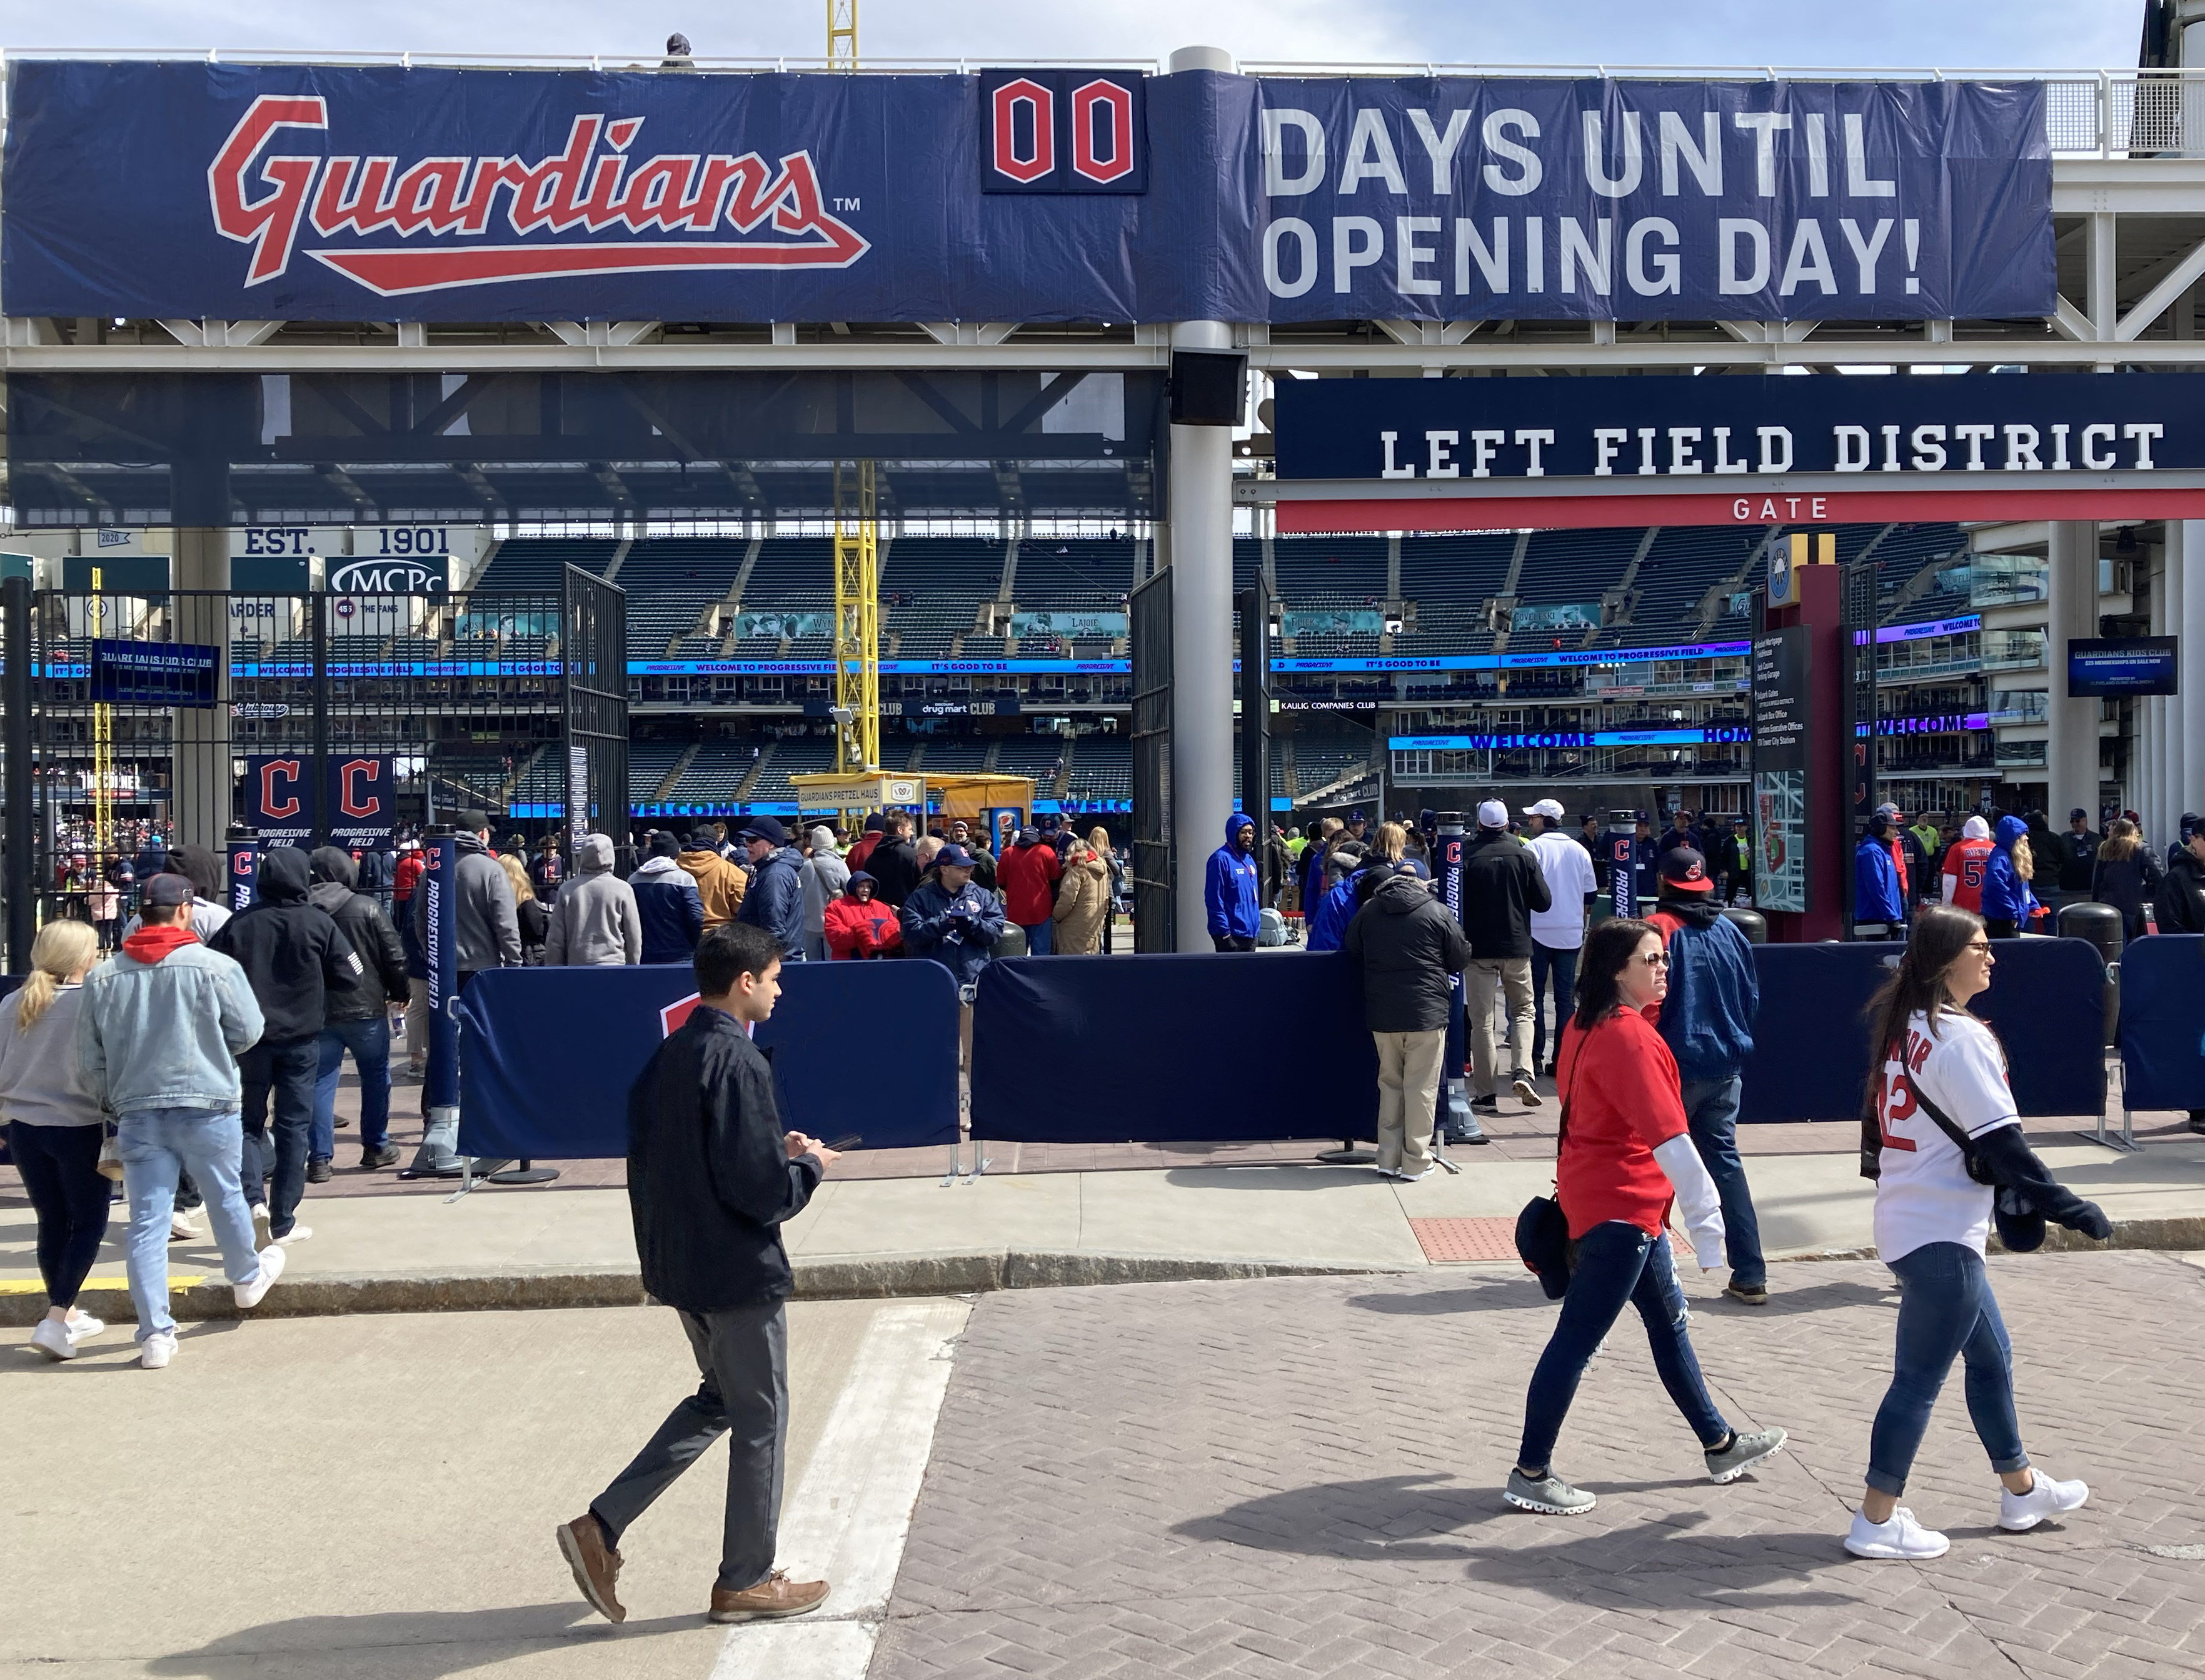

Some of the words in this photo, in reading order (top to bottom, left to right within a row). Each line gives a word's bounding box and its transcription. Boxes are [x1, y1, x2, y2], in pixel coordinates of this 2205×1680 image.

[992, 77, 1135, 184] 00
[1262, 108, 1543, 196] DAYS
[1582, 109, 1896, 198] UNTIL
[208, 94, 863, 292] Guardians
[833, 198, 861, 211] TM
[1263, 216, 1680, 299] OPENING
[1719, 218, 1921, 296] DAY!
[1380, 429, 1555, 479] LEFT
[1594, 426, 1793, 476] FIELD
[1833, 423, 2164, 472] DISTRICT
[1732, 497, 1827, 521] GATE
[101, 533, 119, 542] 2020
[245, 528, 315, 554] EST.
[379, 528, 449, 554] 1901
[361, 605, 376, 613] THE
[378, 605, 398, 613] FANS
[1514, 611, 1555, 622] COVELESKI
[1072, 618, 1098, 627] LAJOIE
[1942, 619, 1973, 631] WELCOME
[1559, 654, 1602, 662] WELCOME
[1604, 653, 1616, 661] TO
[1618, 649, 1680, 659] PROGRESSIVE
[1681, 648, 1704, 656] FIELD
[2074, 649, 2124, 659] GUARDIANS
[2126, 649, 2147, 658] KIDS
[2148, 648, 2171, 657] CLUB
[922, 704, 944, 715] drug
[945, 704, 967, 713] mart
[970, 702, 995, 715] CLUB
[1776, 709, 1787, 719] Office
[1788, 721, 1803, 731] Offices
[1876, 714, 1969, 735] WELCOME
[1469, 732, 1596, 749] WELCOME
[1779, 735, 1796, 745] Station
[260, 758, 300, 819] C
[341, 758, 380, 819] C
[800, 790, 833, 802] GUARDIANS
[833, 789, 860, 801] PRETZEL
[861, 788, 878, 800] HAUS
[1333, 792, 1347, 801] drug
[1347, 789, 1361, 799] mart
[1362, 783, 1379, 798] CLUB
[258, 828, 313, 838] ROGRESSIVE
[330, 828, 392, 838] PROGRESSIVE
[267, 838, 295, 848] FIELD
[348, 838, 374, 847] FIELD
[1614, 839, 1630, 861] C
[426, 848, 441, 871] C
[1447, 842, 1461, 864] C
[234, 851, 252, 875] C
[427, 878, 439, 968] PROGRESSIVE
[428, 969, 439, 1009] FIELD
